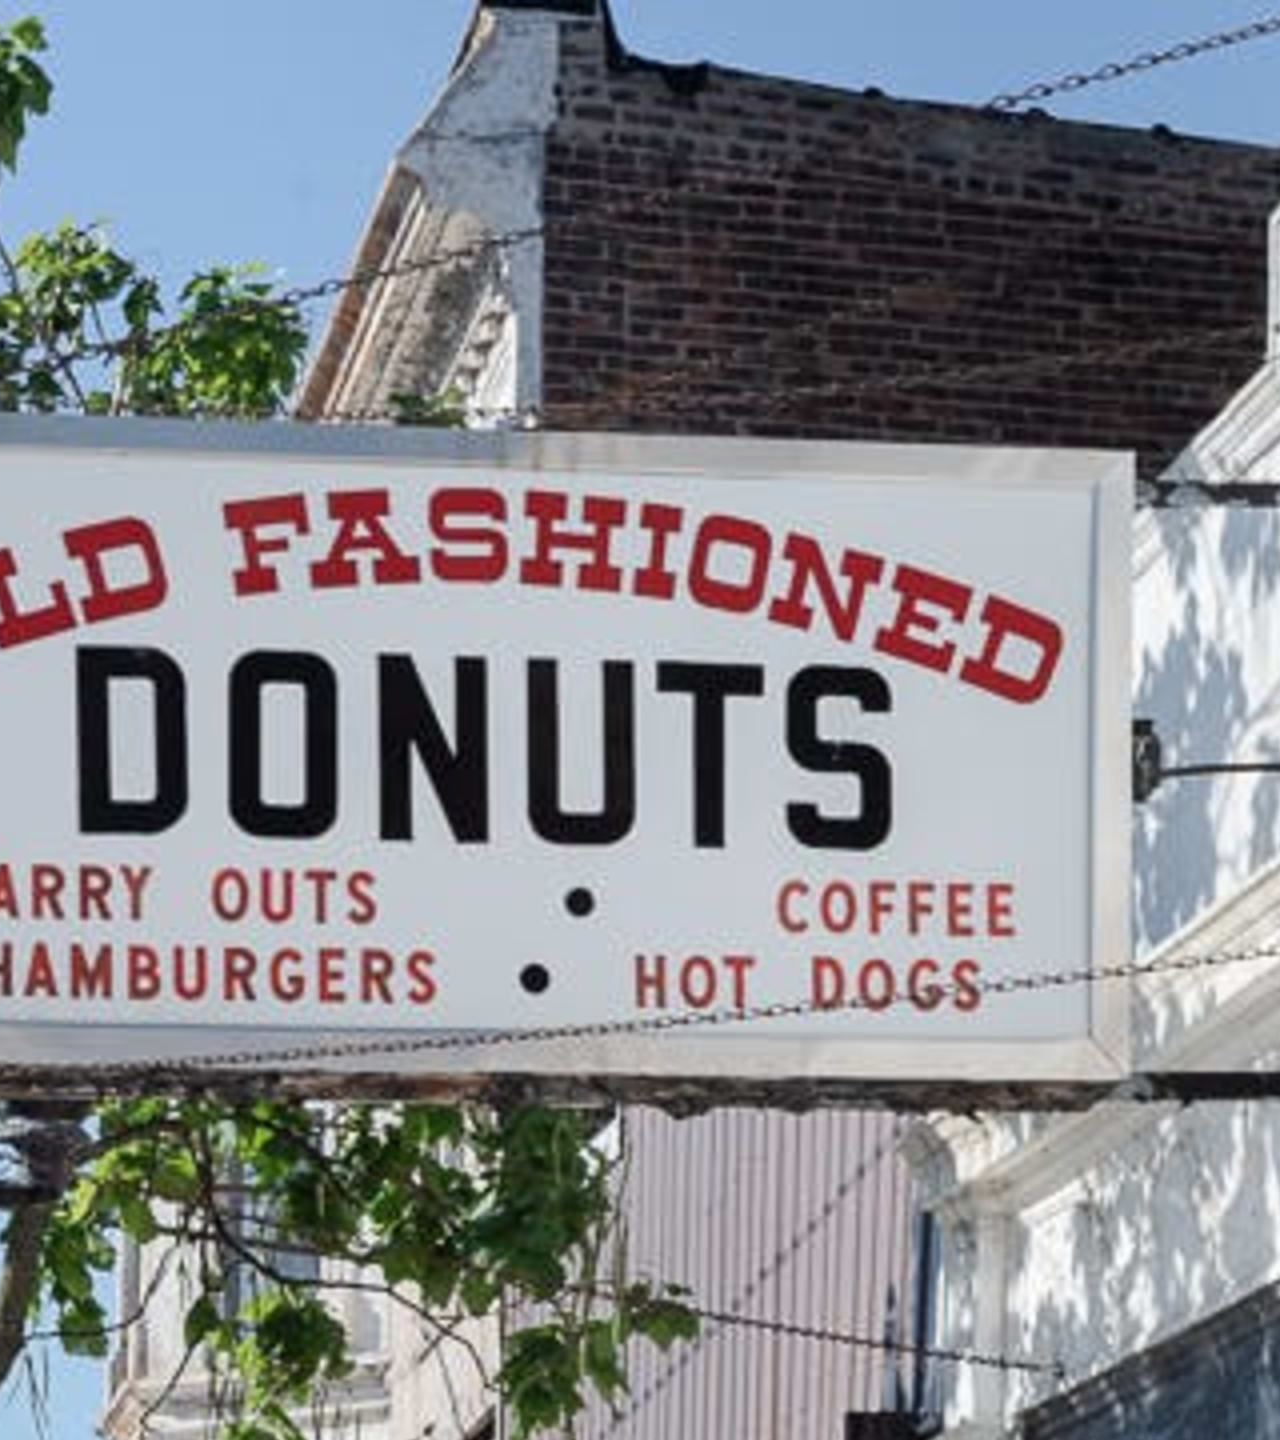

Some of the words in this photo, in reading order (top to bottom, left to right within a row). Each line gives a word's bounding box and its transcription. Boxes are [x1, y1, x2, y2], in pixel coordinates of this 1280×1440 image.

[223, 487, 1064, 704] FASHIONED
[76, 644, 892, 851] DONUTS
[212, 868, 377, 924] OUTS
[778, 880, 1016, 937] COFFEE
[634, 955, 755, 1009] HOT
[812, 957, 982, 1012] DOGS
